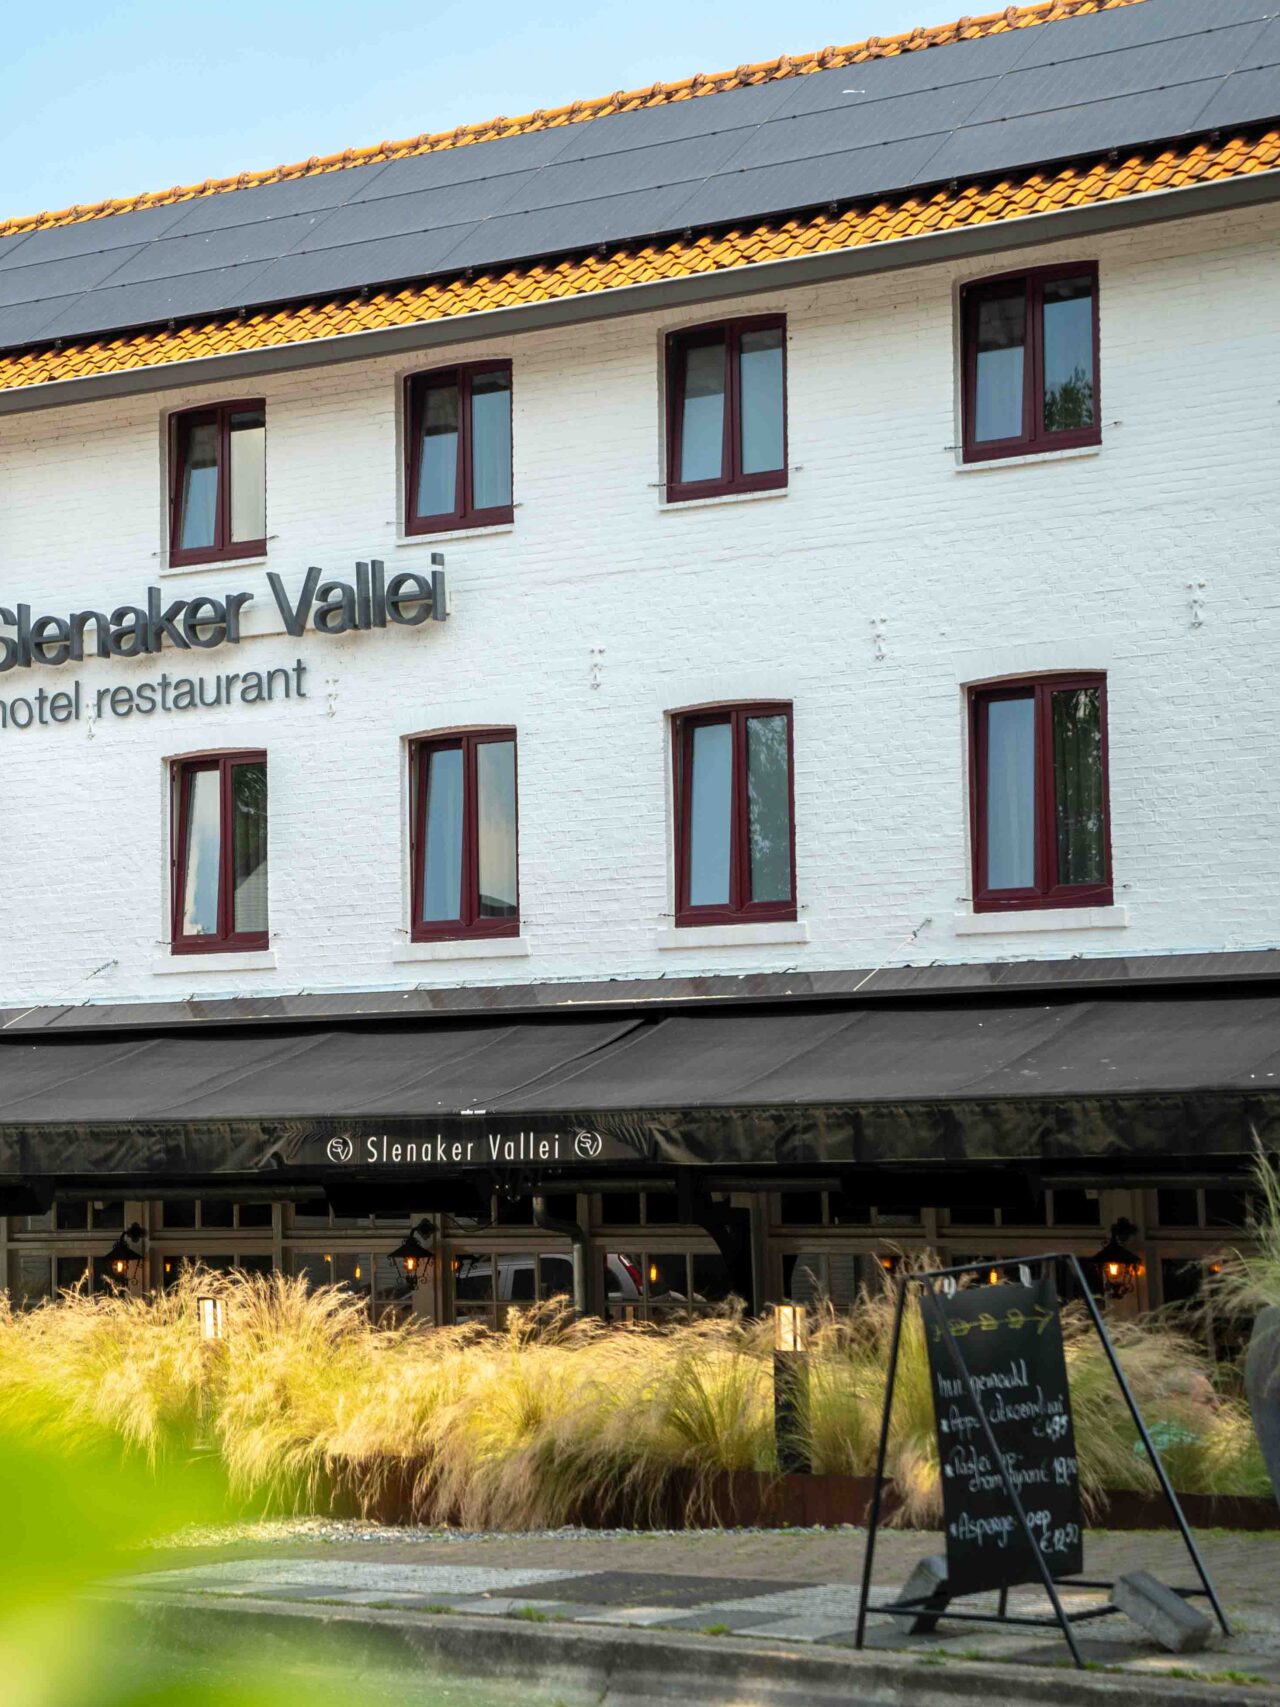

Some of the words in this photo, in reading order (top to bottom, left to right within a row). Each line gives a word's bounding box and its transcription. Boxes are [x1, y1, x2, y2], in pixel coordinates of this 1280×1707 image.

[266, 552, 447, 638] Vallei
[96, 658, 307, 719] restaurant
[366, 1134, 474, 1163] Slenaker
[488, 1132, 560, 1161] Vallei
